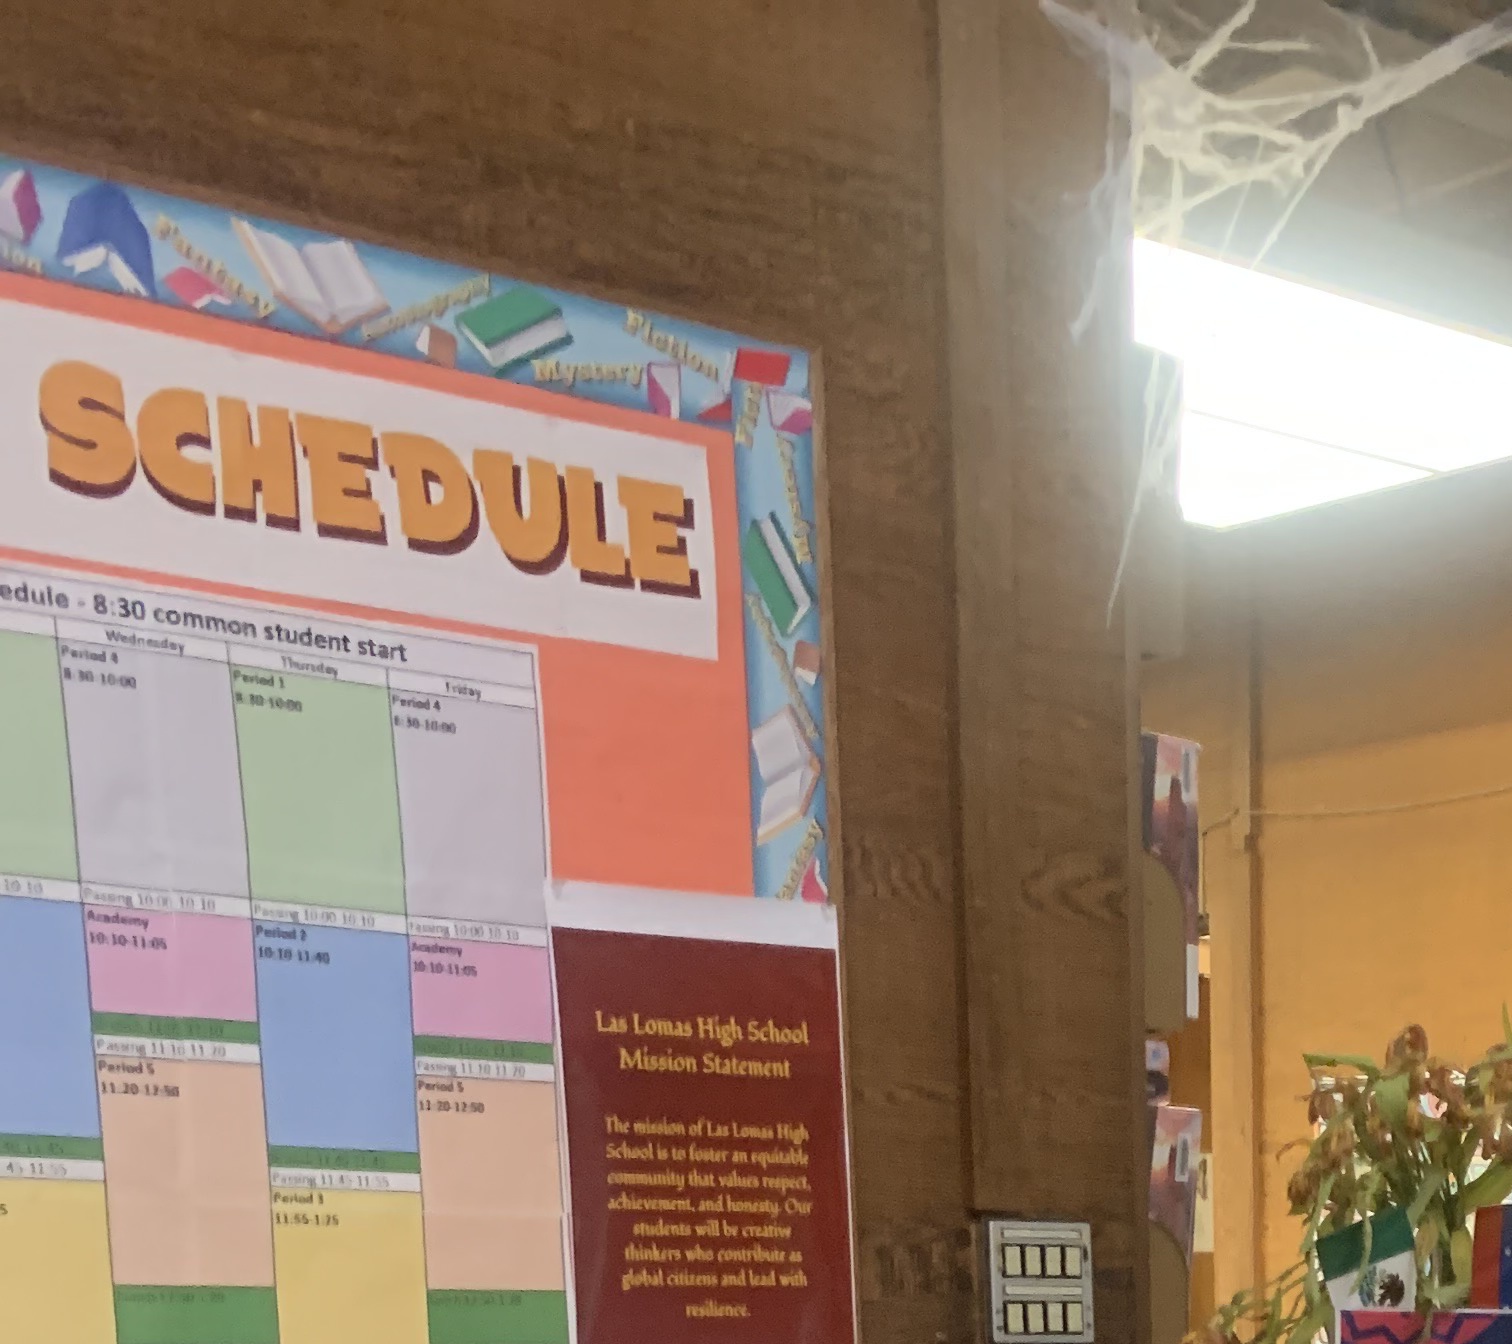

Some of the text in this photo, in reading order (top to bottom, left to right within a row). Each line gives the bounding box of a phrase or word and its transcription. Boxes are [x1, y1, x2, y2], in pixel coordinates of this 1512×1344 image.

[532, 358, 643, 387] Mystery
[38, 359, 702, 598] SCHEDULE
[93, 594, 146, 620] 8:30
[154, 606, 257, 638] common
[264, 623, 351, 653] student
[357, 639, 408, 662] start
[60, 645, 107, 662] Period
[105, 630, 185, 657] Wednesday
[233, 669, 274, 687] Period
[281, 655, 338, 680] Thursday
[392, 694, 441, 712] Period 4
[88, 910, 149, 930] Academy
[256, 925, 296, 940] Period
[595, 1010, 809, 1047] Las Lomas High School
[98, 1060, 142, 1074] Period
[619, 1047, 790, 1078] Mission Statement
[418, 1080, 464, 1092] Period 5
[606, 1115, 809, 1145] The mission of Las Lomas High
[606, 1143, 808, 1169] School is to foster an equitable
[607, 1169, 811, 1195] community that values respect,
[274, 1193, 314, 1205] Period
[608, 1192, 812, 1217] achievement, and honesty. Our
[633, 1220, 791, 1238] students will be creative
[625, 1242, 802, 1263] thinkers who contribute as
[622, 1269, 807, 1291] global citizens and lead with
[686, 1300, 750, 1317] resilience.
